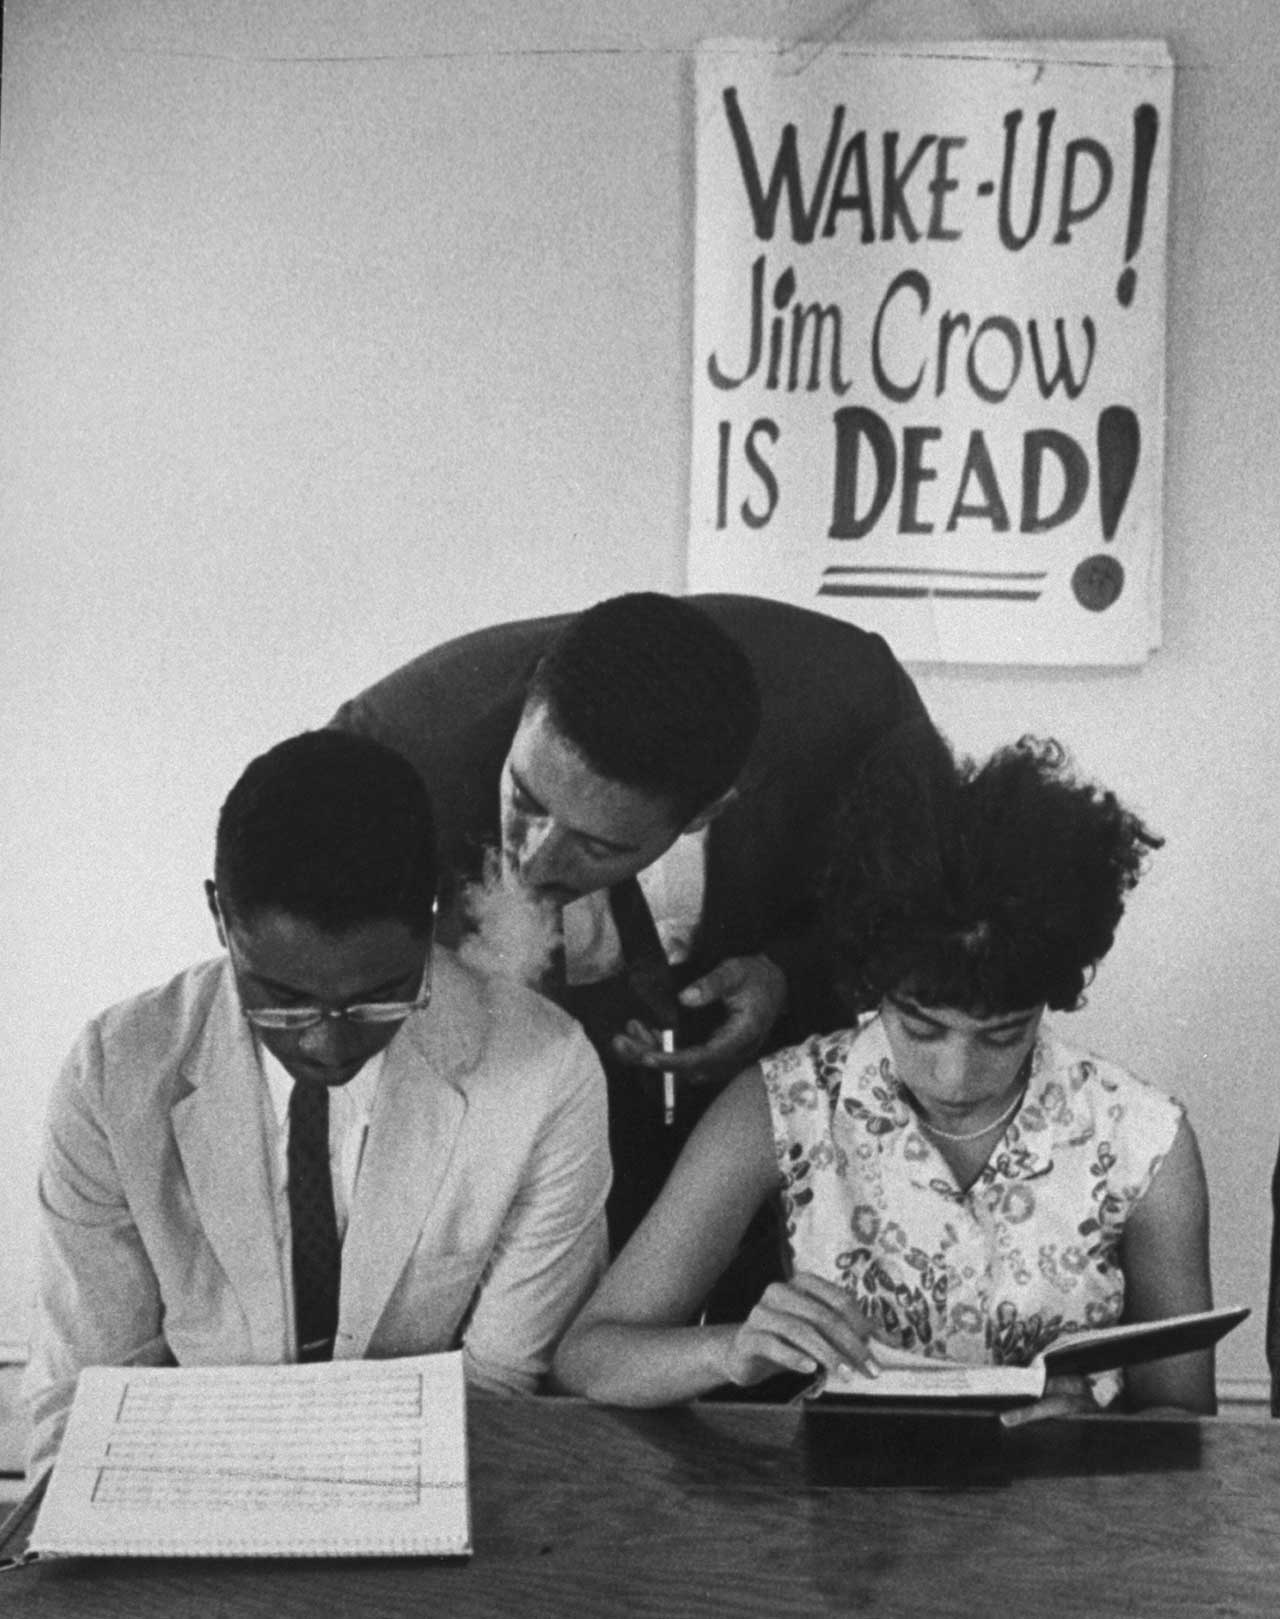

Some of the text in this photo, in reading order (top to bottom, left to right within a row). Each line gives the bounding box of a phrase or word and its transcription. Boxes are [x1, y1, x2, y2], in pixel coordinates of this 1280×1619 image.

[723, 86, 1159, 308] WAKE-UP!
[708, 253, 1096, 404] Jim Crow
[716, 404, 1142, 613] IS DEAD!
